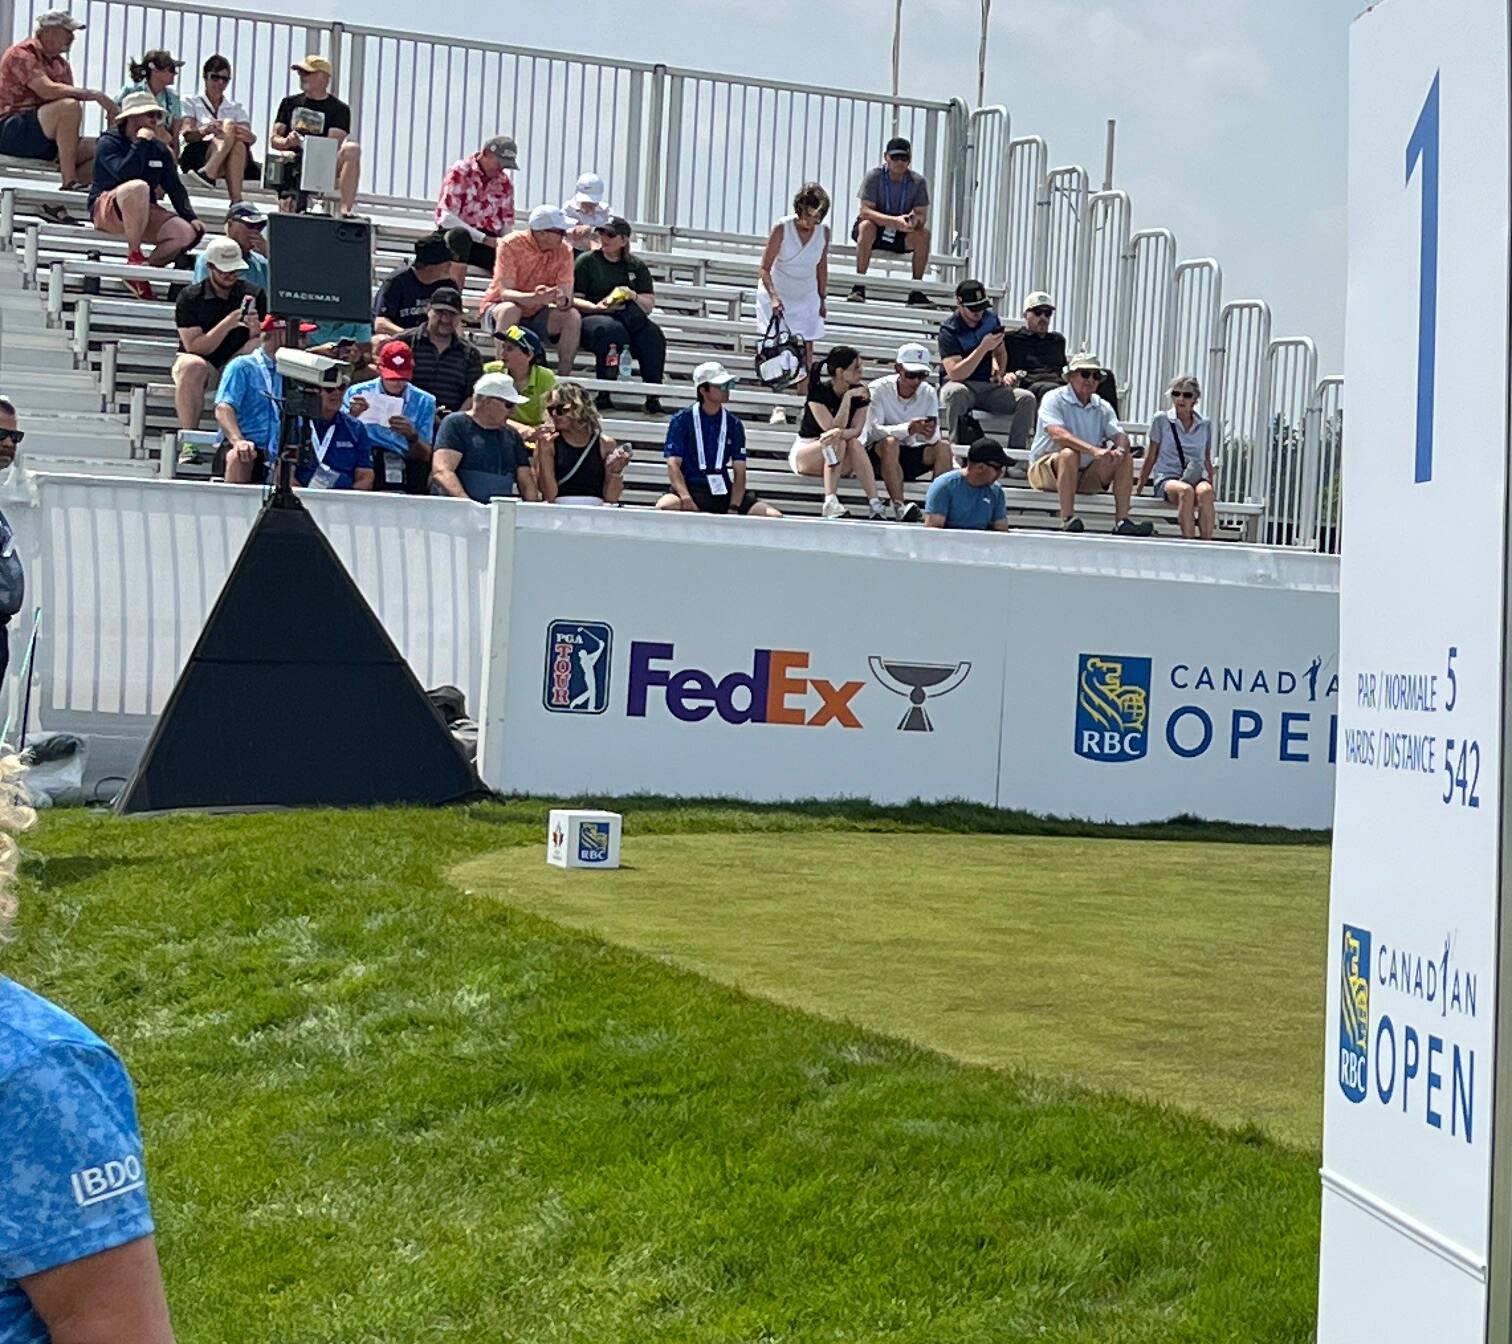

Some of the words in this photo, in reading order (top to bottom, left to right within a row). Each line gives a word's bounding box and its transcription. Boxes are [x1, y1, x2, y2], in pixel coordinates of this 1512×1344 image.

[278, 290, 341, 304] TRACKMAN
[1405, 67, 1440, 483] 1
[556, 633, 584, 645] PGA
[551, 643, 574, 705] TOUR
[625, 640, 866, 731] FedEx
[1170, 656, 1339, 702] CANADIA
[1445, 647, 1458, 712] 5
[1082, 729, 1142, 755] RBC
[1165, 705, 1338, 765] OPE
[1442, 738, 1480, 809] 542
[580, 849, 607, 860] RBC
[1378, 932, 1478, 1018] CANADIAN
[1340, 1047, 1366, 1094] RBC
[1375, 1014, 1475, 1145] OPEN
[79, 1155, 142, 1199] BDO
